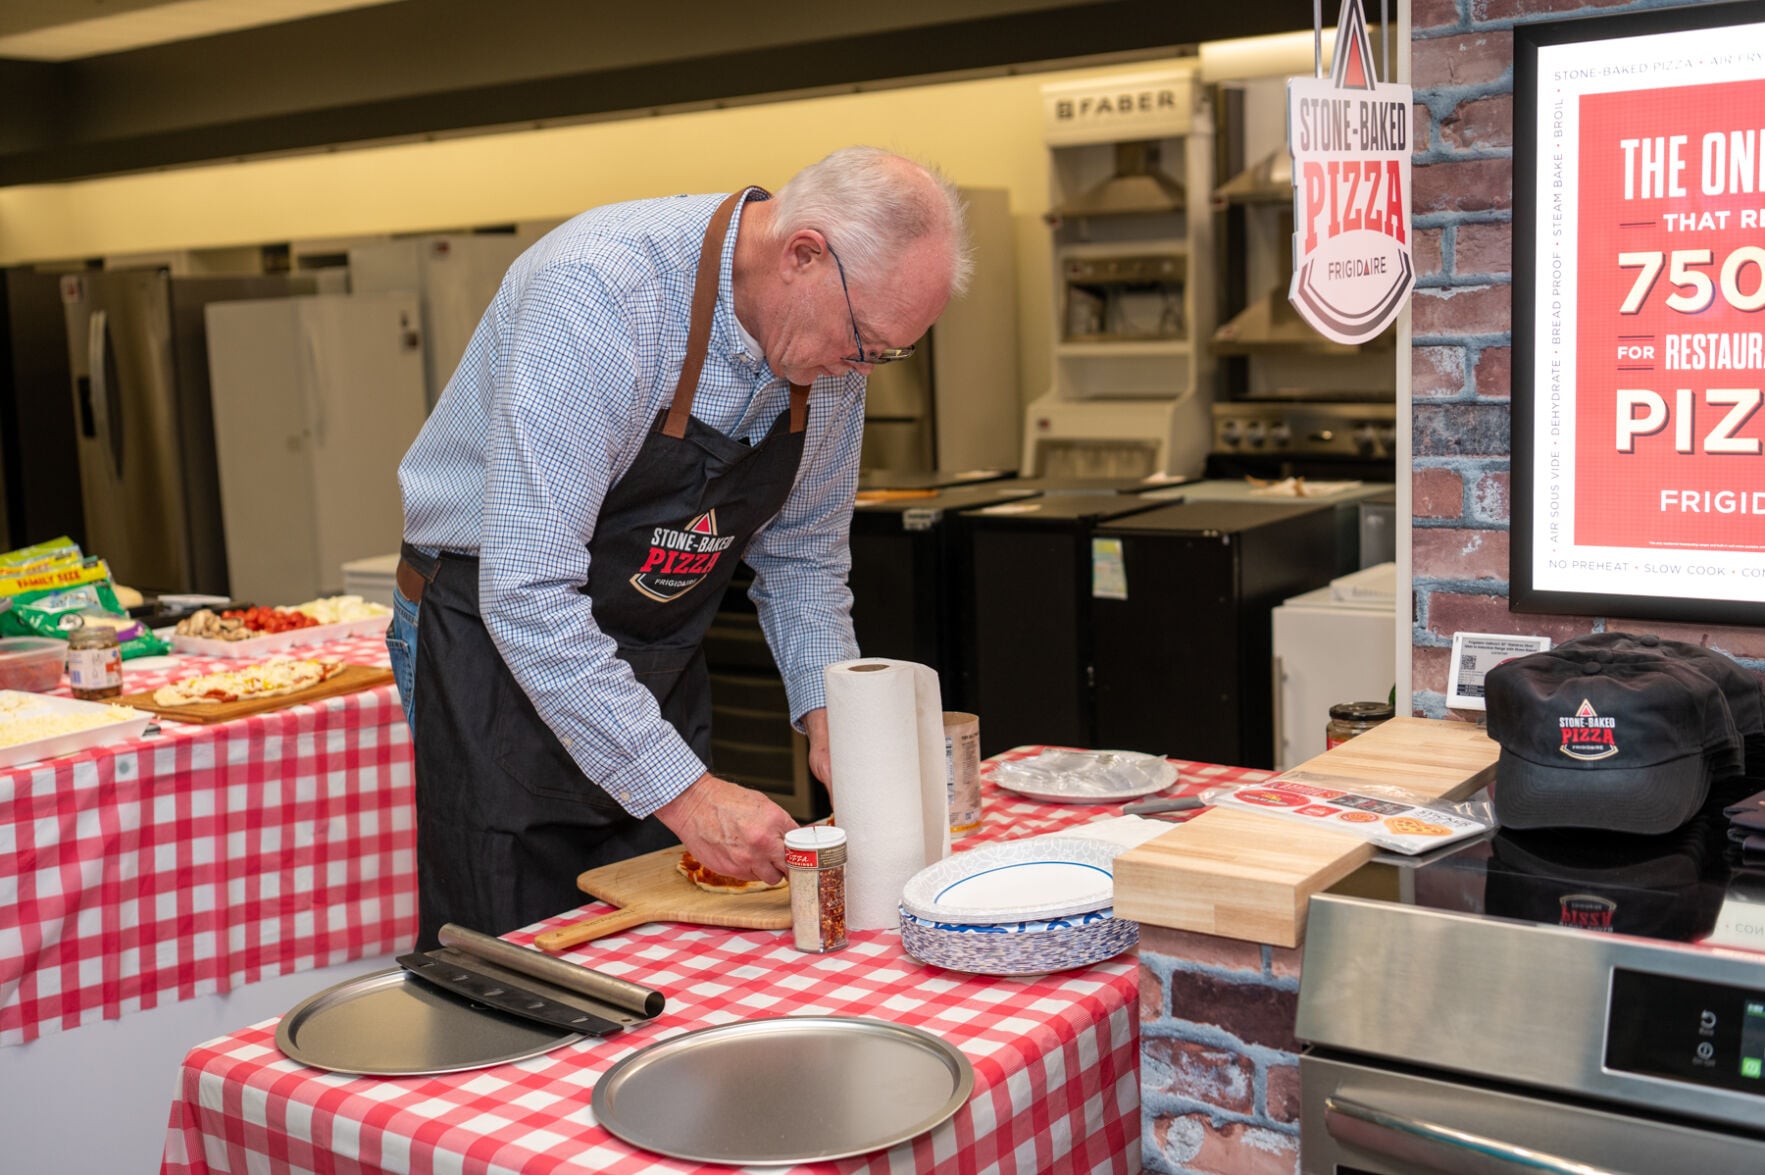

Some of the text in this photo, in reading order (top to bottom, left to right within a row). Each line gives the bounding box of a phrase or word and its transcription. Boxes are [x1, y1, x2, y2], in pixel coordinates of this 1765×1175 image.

[1554, 64, 1648, 81] STONE-BAKED
[1653, 59, 1693, 73] PIZZA
[1080, 90, 1175, 114] FABER
[1300, 98, 1406, 152] STONE-BAKED
[1620, 135, 1688, 200] THE
[1303, 160, 1406, 256] PIZZA
[1663, 211, 1731, 232] THAT
[1328, 256, 1388, 280] FRIGIDAIRE
[1550, 99, 1564, 544] AIR SOUS VIDE DEHYDRATE BREAD PROOF STEAM BAKE BROIL
[1617, 332, 1765, 370] FOR RESTAUR
[651, 527, 735, 553] STONE-BAKED
[640, 547, 721, 574] PIZZA
[1549, 559, 1568, 570] NO
[1572, 560, 1630, 572] PREHEAT
[1644, 563, 1682, 575] SLOW
[1687, 565, 1726, 577] COOK
[1559, 717, 1616, 728] STONE-BAKED
[1561, 727, 1616, 746] PIZZA
